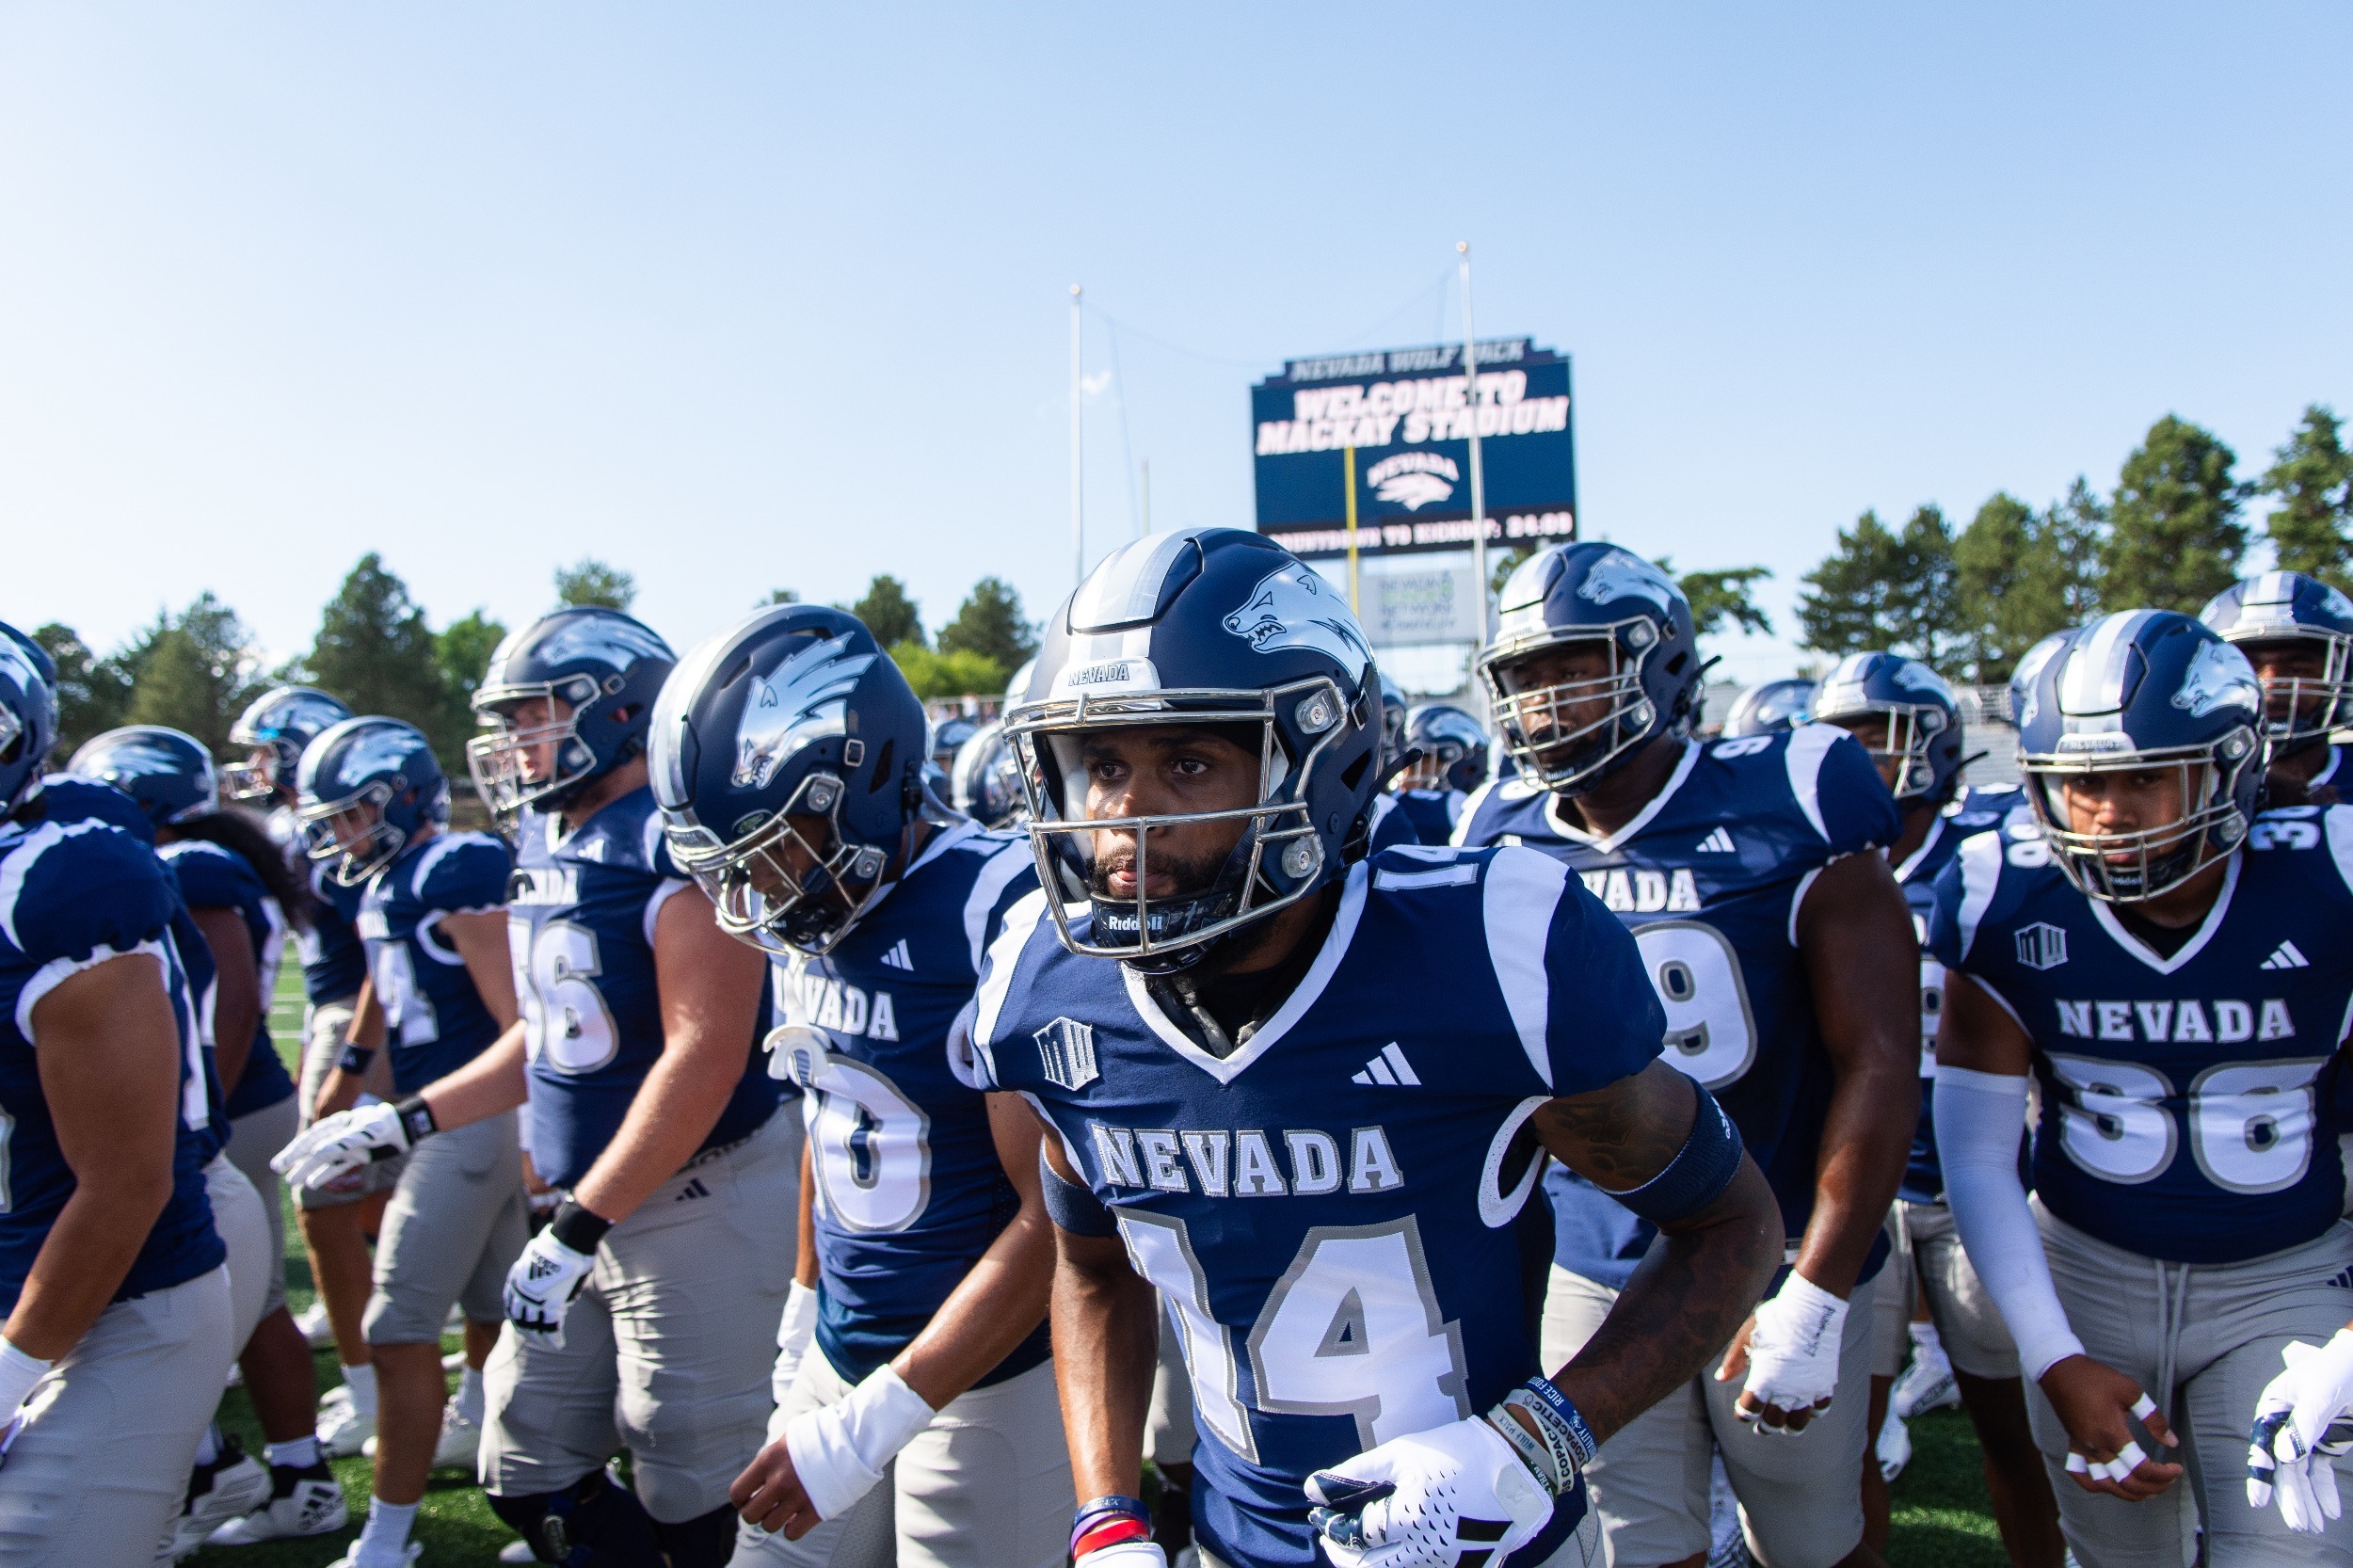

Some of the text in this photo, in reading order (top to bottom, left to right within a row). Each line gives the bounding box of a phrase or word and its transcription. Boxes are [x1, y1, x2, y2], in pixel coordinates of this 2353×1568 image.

[1290, 353, 1385, 381] NEVADA
[1388, 345, 1459, 374] WOLF
[1294, 369, 1527, 422] WELCOME TO
[1256, 395, 1570, 456] MACKAY STADIUM
[1367, 451, 1460, 489] NEVADA
[1383, 523, 1413, 547] TO
[1067, 664, 1130, 687] NEVADA
[2055, 998, 2297, 1044] NEVADA
[2041, 1049, 2331, 1195] 36
[1090, 1124, 1406, 1198] NEVADA
[1105, 1203, 1474, 1466] 14
[1543, 1384, 1565, 1408] RICE
[1514, 1432, 1535, 1453] WOLF
[1531, 1400, 1586, 1464] COPACETIC
